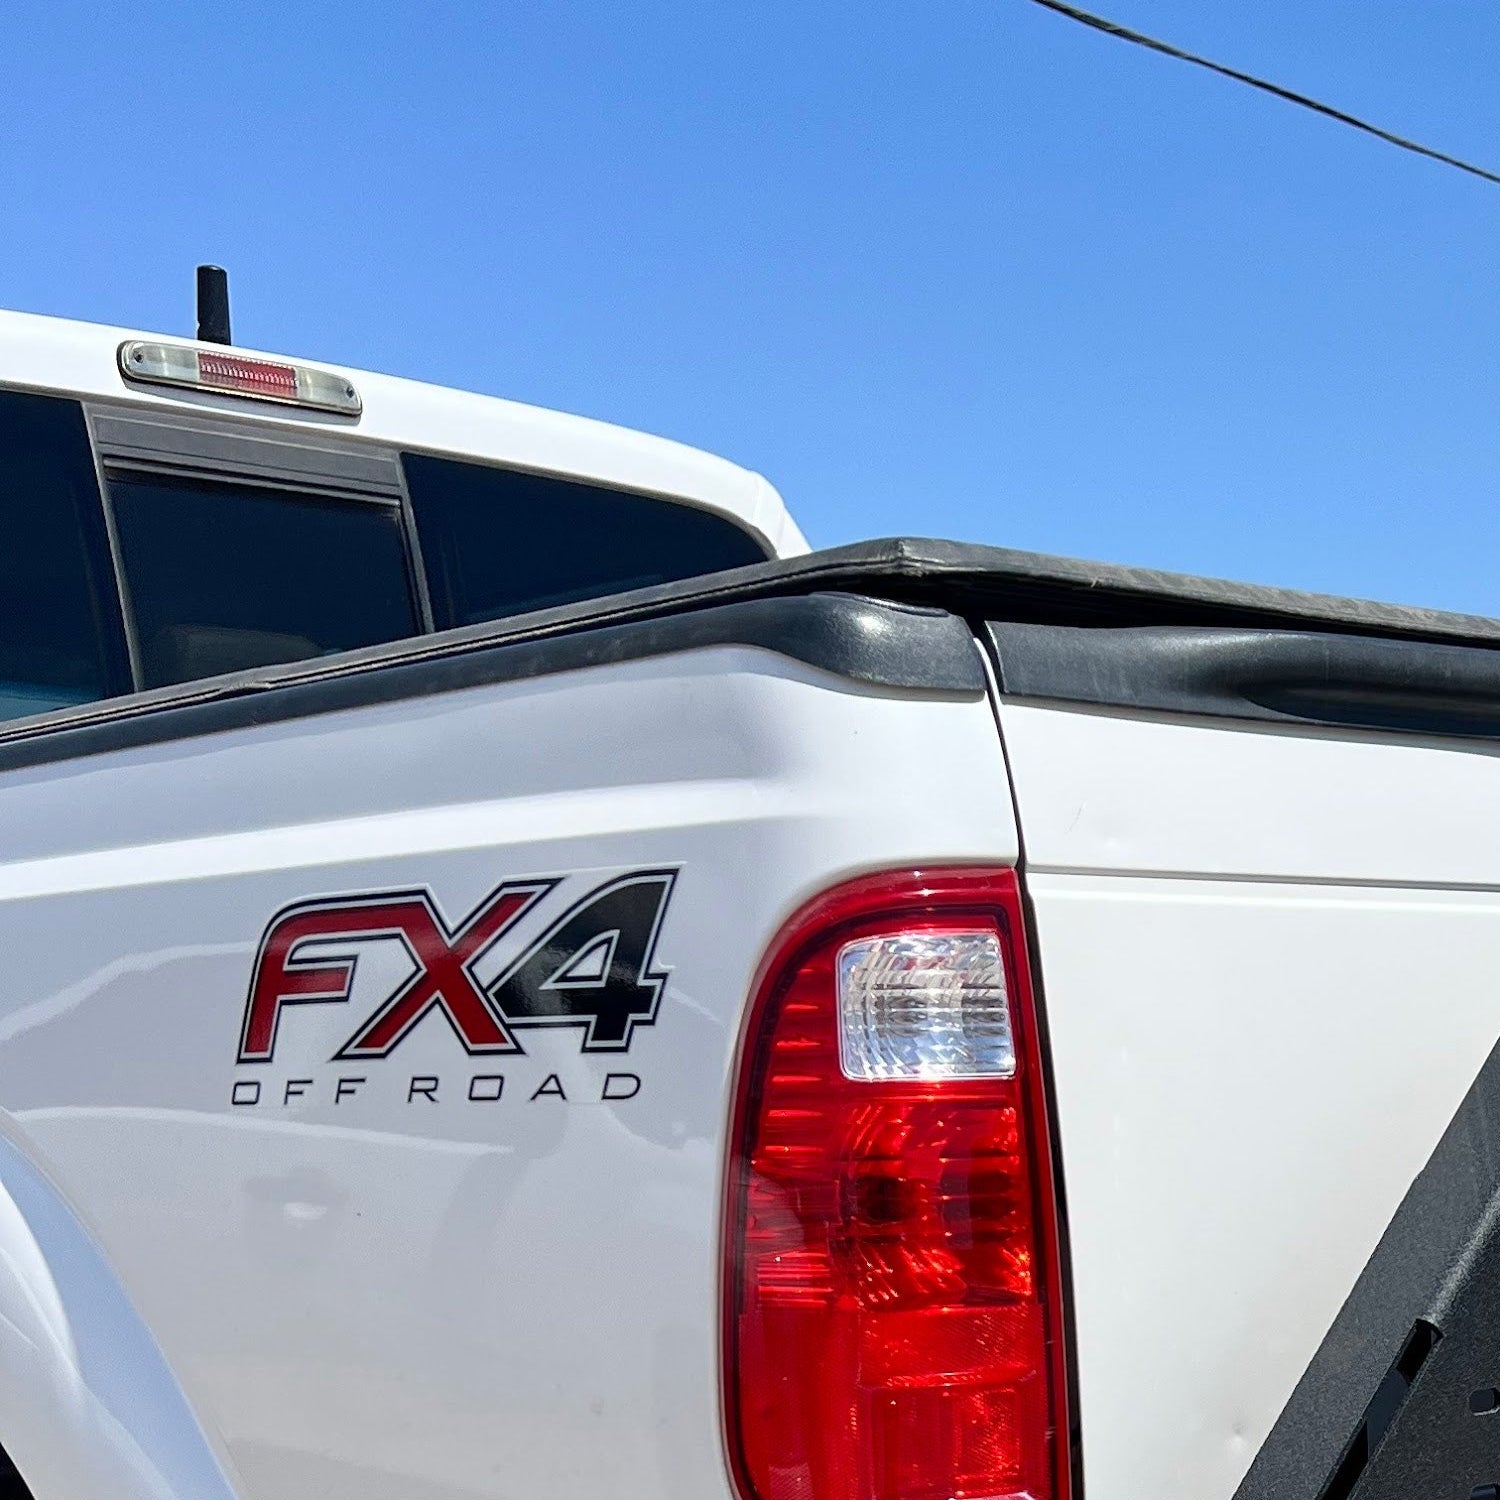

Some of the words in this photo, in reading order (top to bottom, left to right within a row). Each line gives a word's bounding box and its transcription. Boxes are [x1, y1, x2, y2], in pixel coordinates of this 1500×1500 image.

[236, 867, 681, 1064] FX4
[231, 1077, 367, 1106] OFF
[407, 1073, 642, 1102] ROAD
